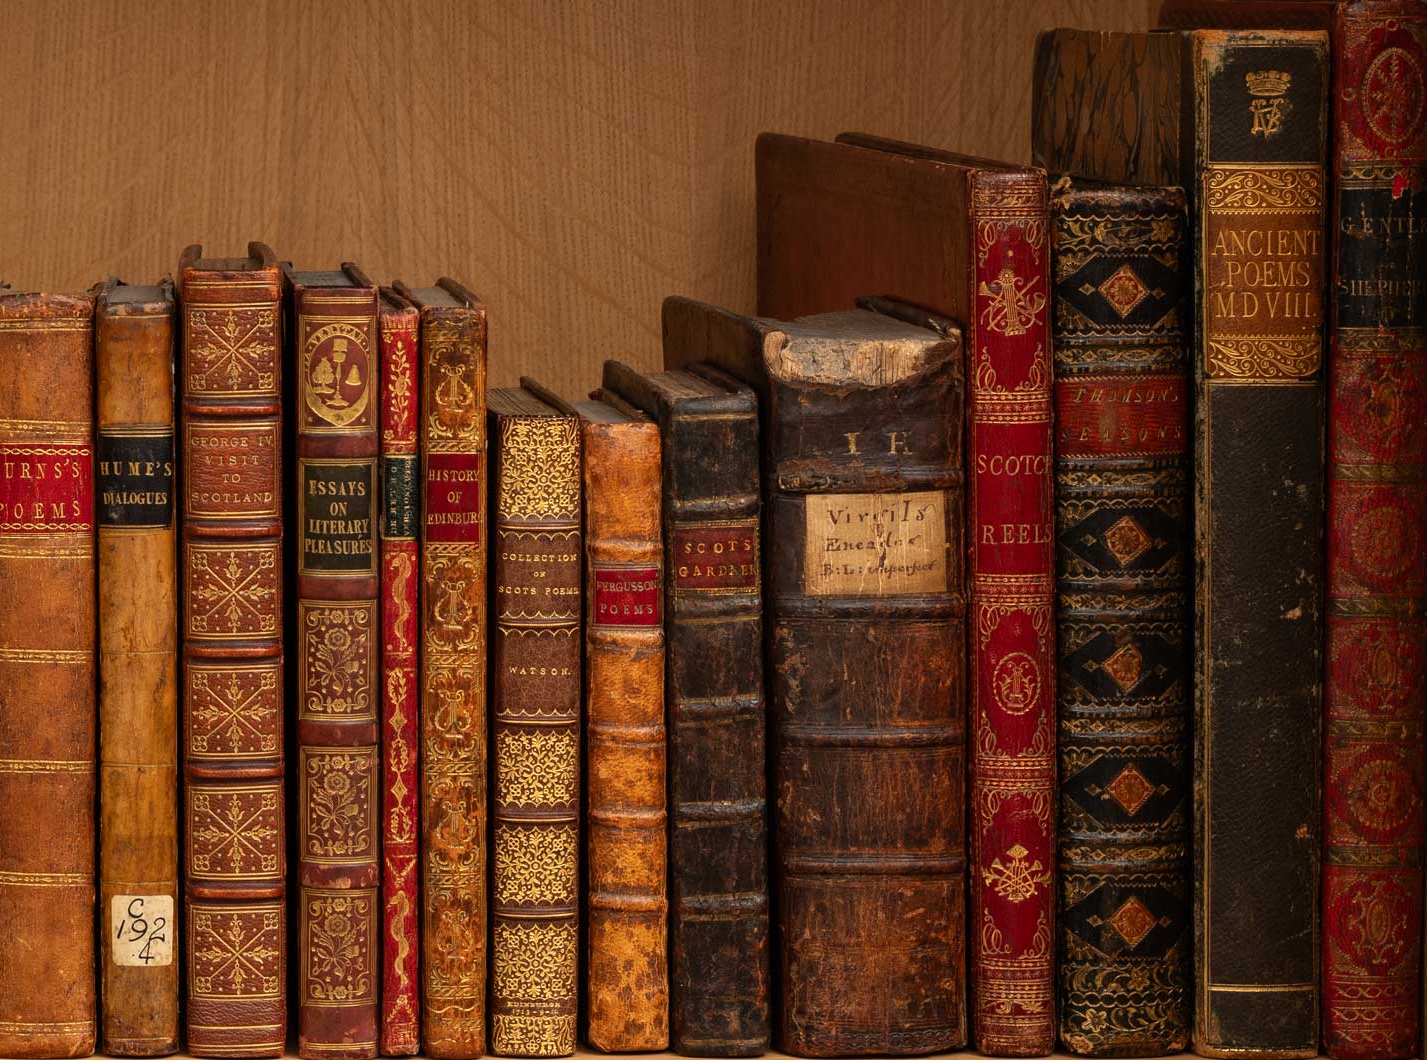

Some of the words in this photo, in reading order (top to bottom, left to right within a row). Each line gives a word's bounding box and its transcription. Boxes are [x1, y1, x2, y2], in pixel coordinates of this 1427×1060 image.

[1211, 229, 1321, 256] ANCIENT
[1225, 260, 1311, 287] POEMS
[191, 437, 249, 448] GEORGE
[205, 455, 260, 466] VISIT
[99, 461, 172, 477] HUME'S
[428, 469, 480, 482] HISTORY
[221, 473, 242, 484] TO
[309, 480, 366, 496] ESSAYS
[103, 492, 168, 505] DIALOGUES
[191, 492, 273, 503] SCOTLAND
[447, 491, 463, 504] OF
[329, 501, 348, 517] ON
[309, 518, 370, 535] LITERARY
[980, 523, 1053, 545] REELS
[304, 538, 374, 555] PLEASURES
[684, 539, 752, 554] SCOTS
[501, 552, 578, 563] COLLECTION
[498, 585, 538, 596] SCOTS
[545, 586, 580, 596] POEMS
[599, 602, 654, 615] POEMS
[128, 898, 145, 918] C
[116, 917, 166, 943] 192
